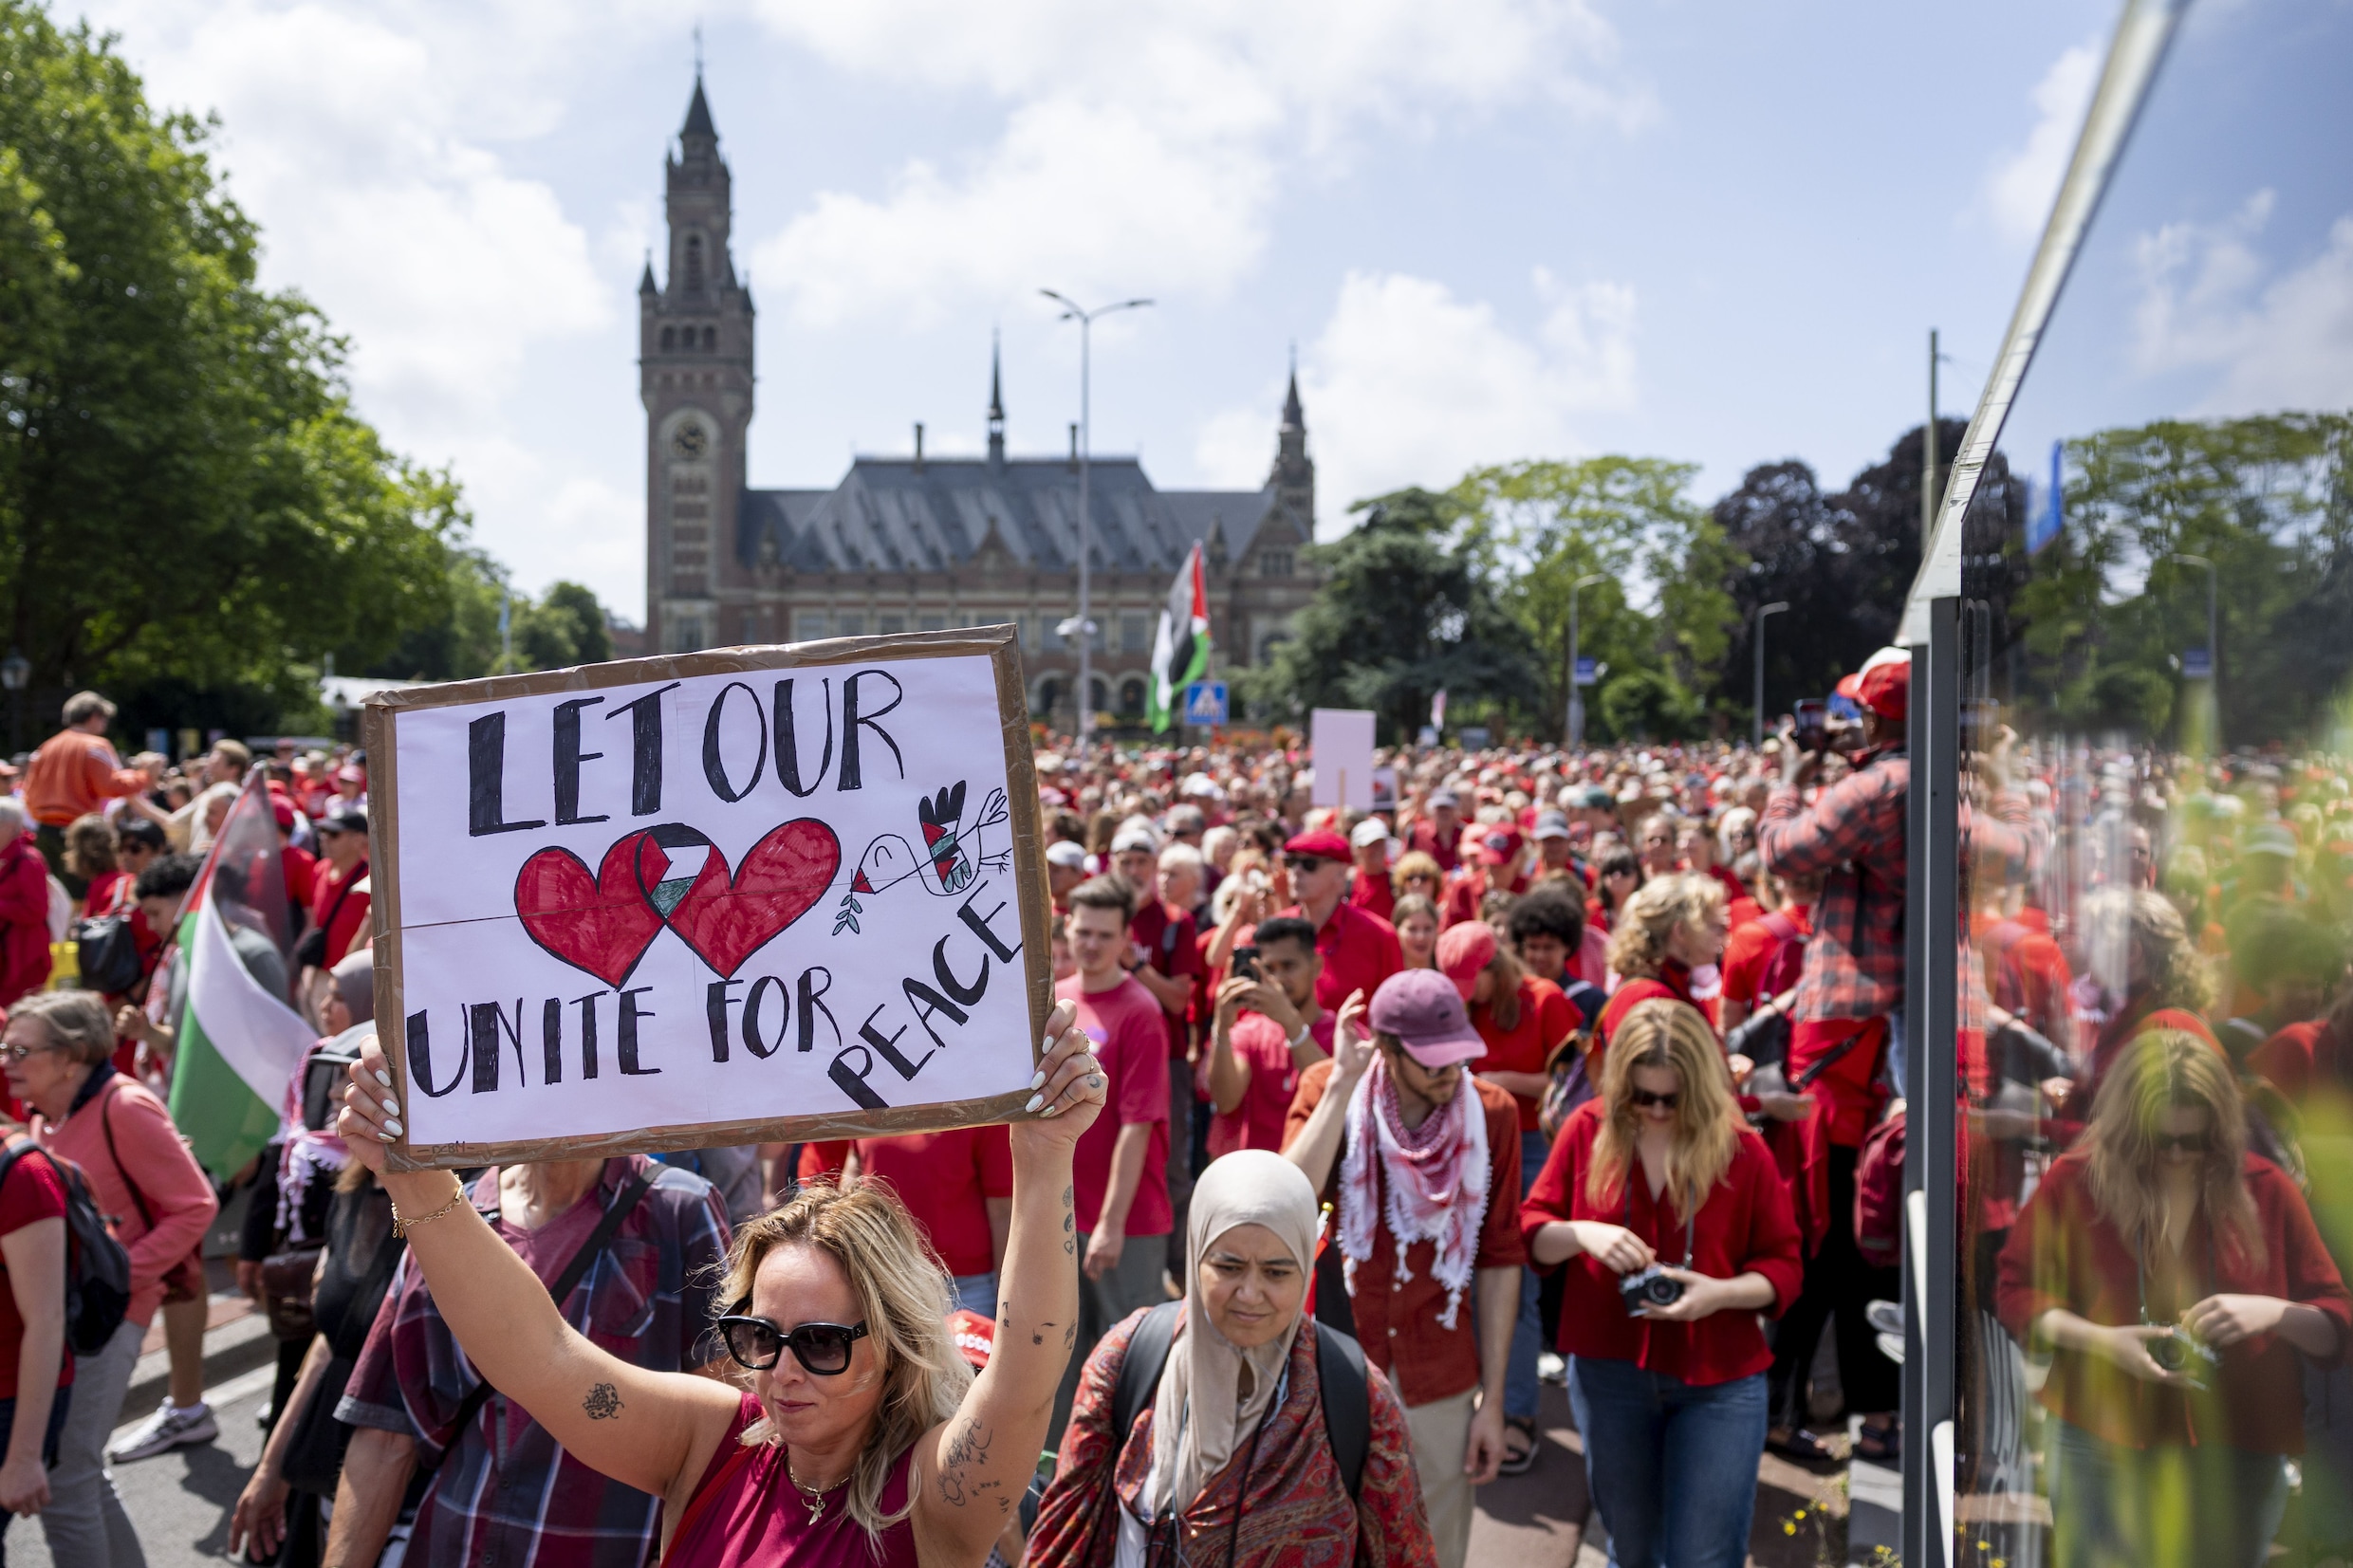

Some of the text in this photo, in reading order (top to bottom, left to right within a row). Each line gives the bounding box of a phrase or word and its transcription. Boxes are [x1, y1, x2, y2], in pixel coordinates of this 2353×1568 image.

[469, 670, 903, 837] LET OUR
[406, 967, 843, 1098] UNITE FOR
[827, 880, 1024, 1111] PEACE
